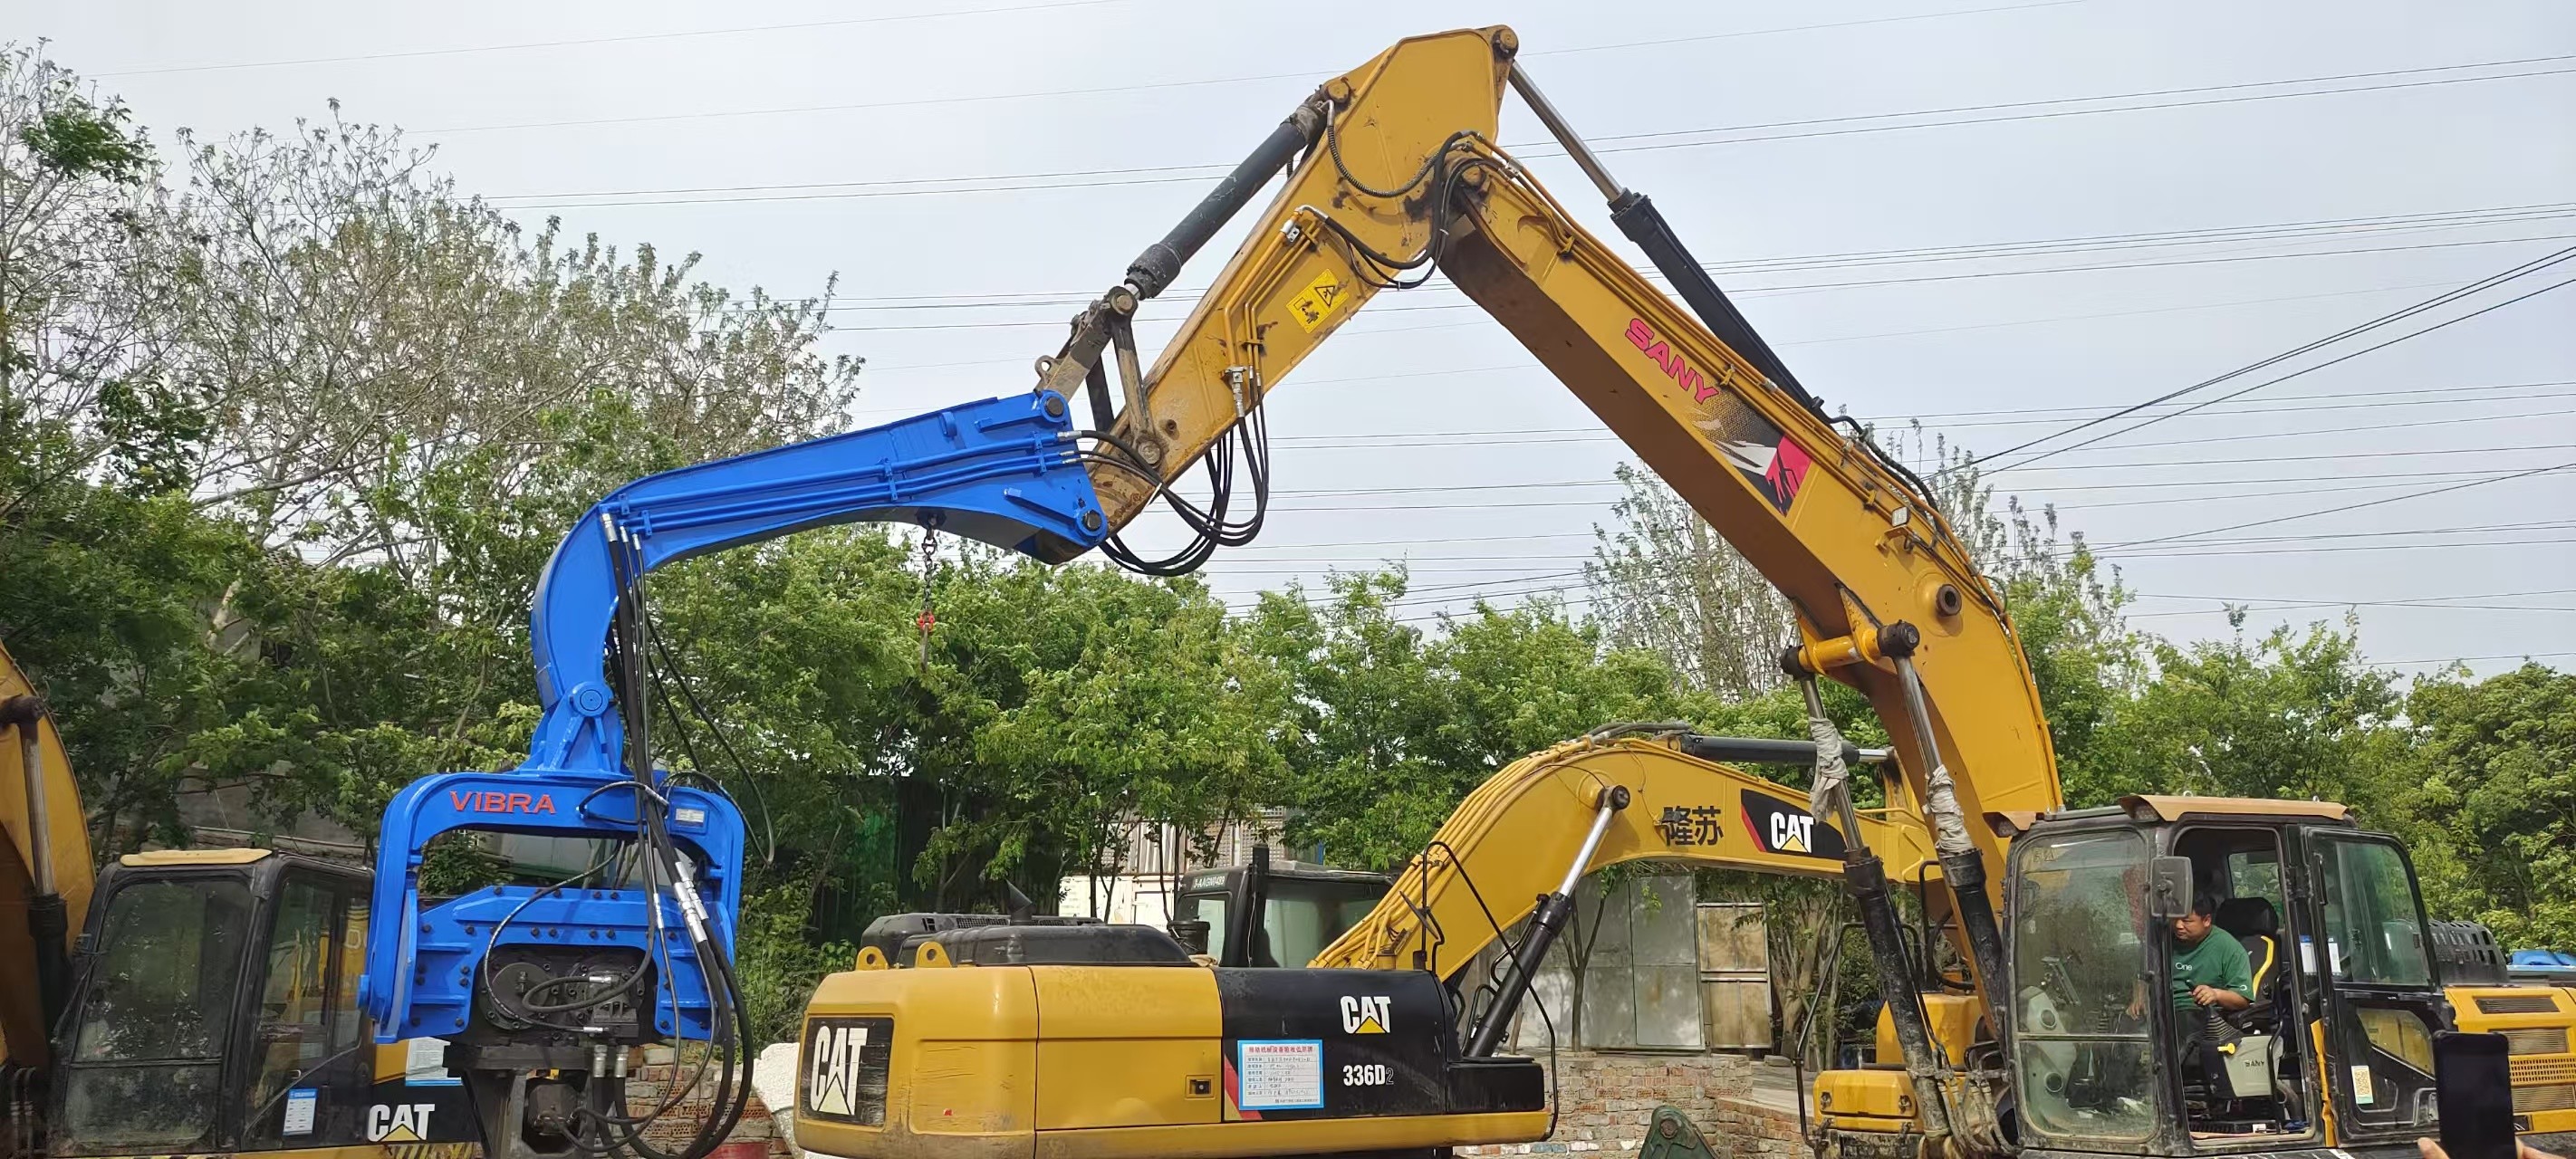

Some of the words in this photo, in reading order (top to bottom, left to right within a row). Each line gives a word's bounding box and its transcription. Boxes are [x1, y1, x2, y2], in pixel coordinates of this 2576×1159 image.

[1625, 318, 1719, 405] SANY
[449, 791, 556, 814] VIBRA
[1771, 811, 1813, 853] CAT
[2175, 962, 2193, 971] One
[1341, 996, 1391, 1034] CAT
[811, 1025, 869, 1116] CAT
[1342, 1064, 1394, 1087] 336D2
[367, 1104, 435, 1142] CAT
